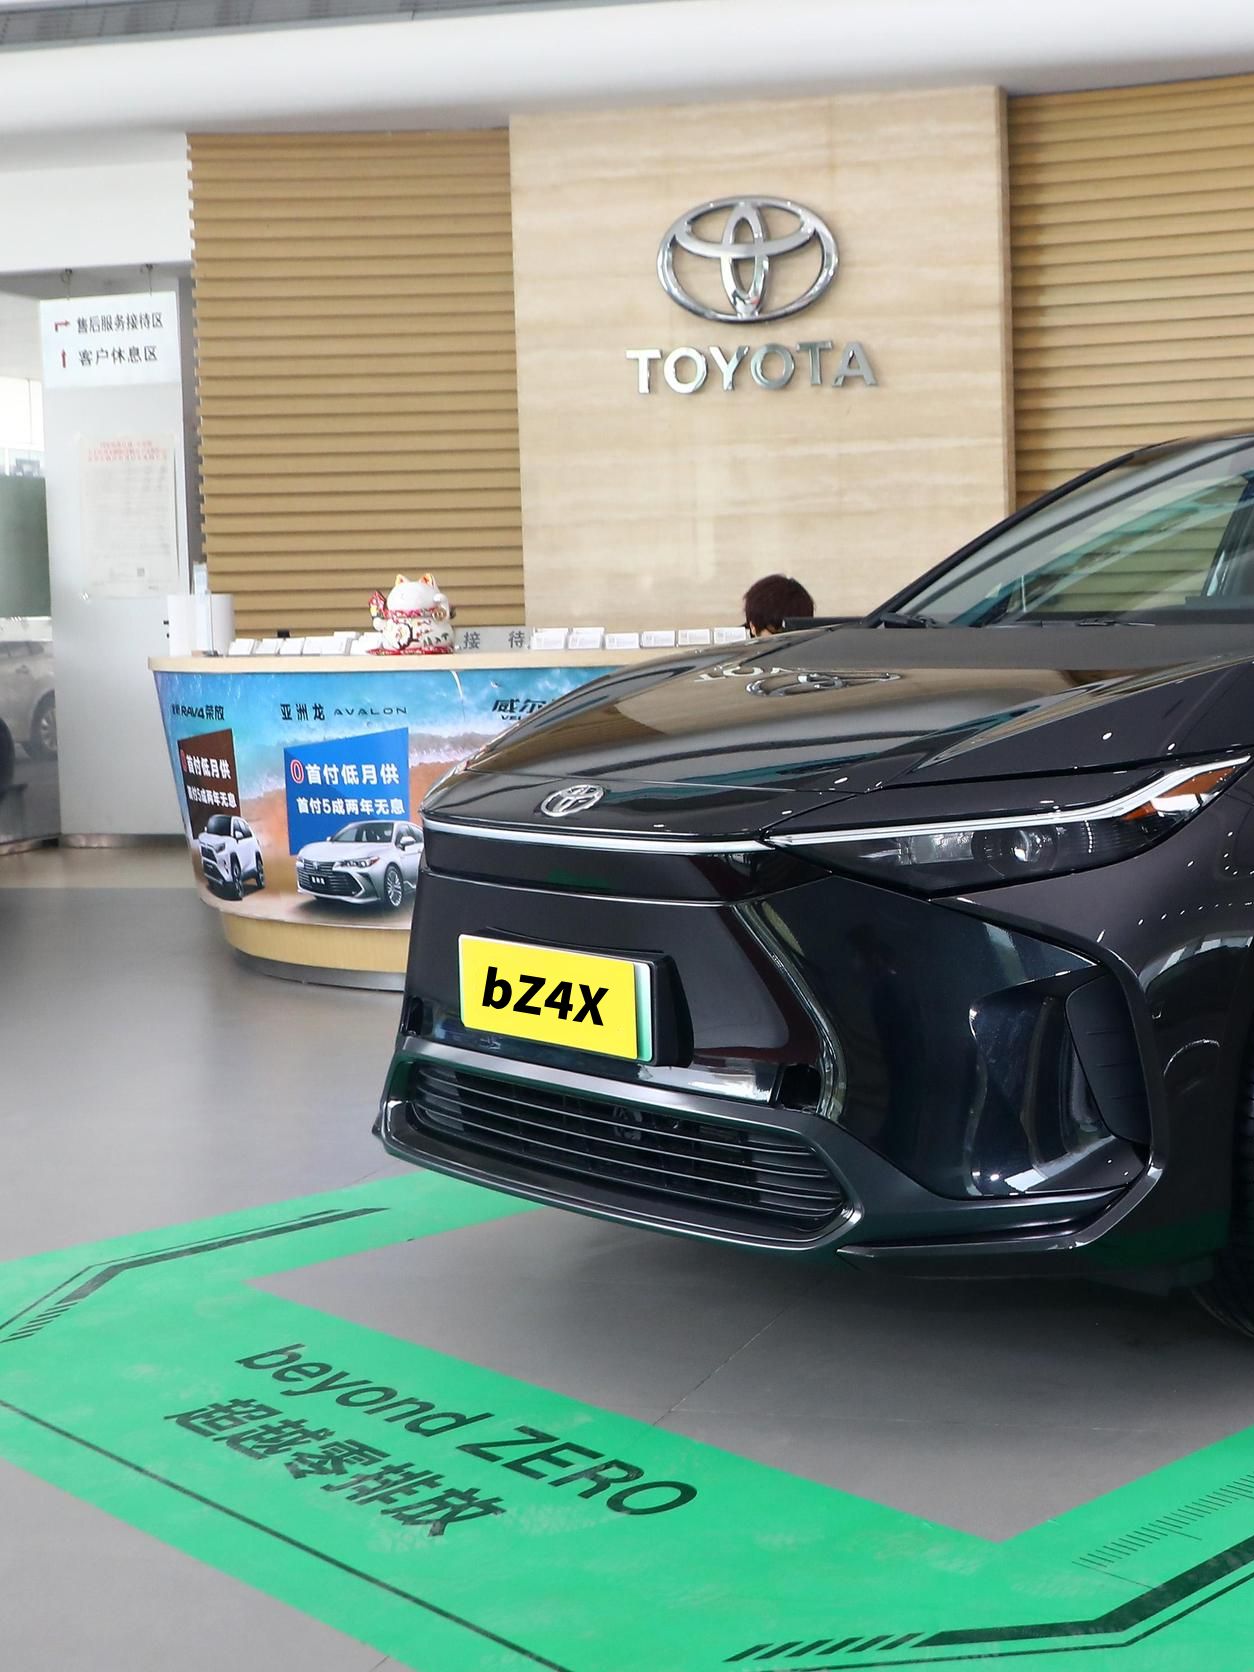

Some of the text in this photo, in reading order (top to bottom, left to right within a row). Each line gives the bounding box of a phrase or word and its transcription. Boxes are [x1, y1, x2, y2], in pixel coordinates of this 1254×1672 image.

[77, 311, 163, 334] 售后服务接待区
[79, 345, 158, 367] 客户休息区
[625, 340, 878, 395] TOYOTA
[280, 703, 408, 721] 亚洲龙 AVALON
[491, 698, 556, 714] 威尔
[290, 759, 401, 785] 0首付低月供
[296, 796, 406, 815] 首付5成两年无息
[481, 965, 610, 1027] bZ4X
[234, 1343, 698, 1516] beyond ZERO
[163, 1397, 507, 1538] 超越零排放
